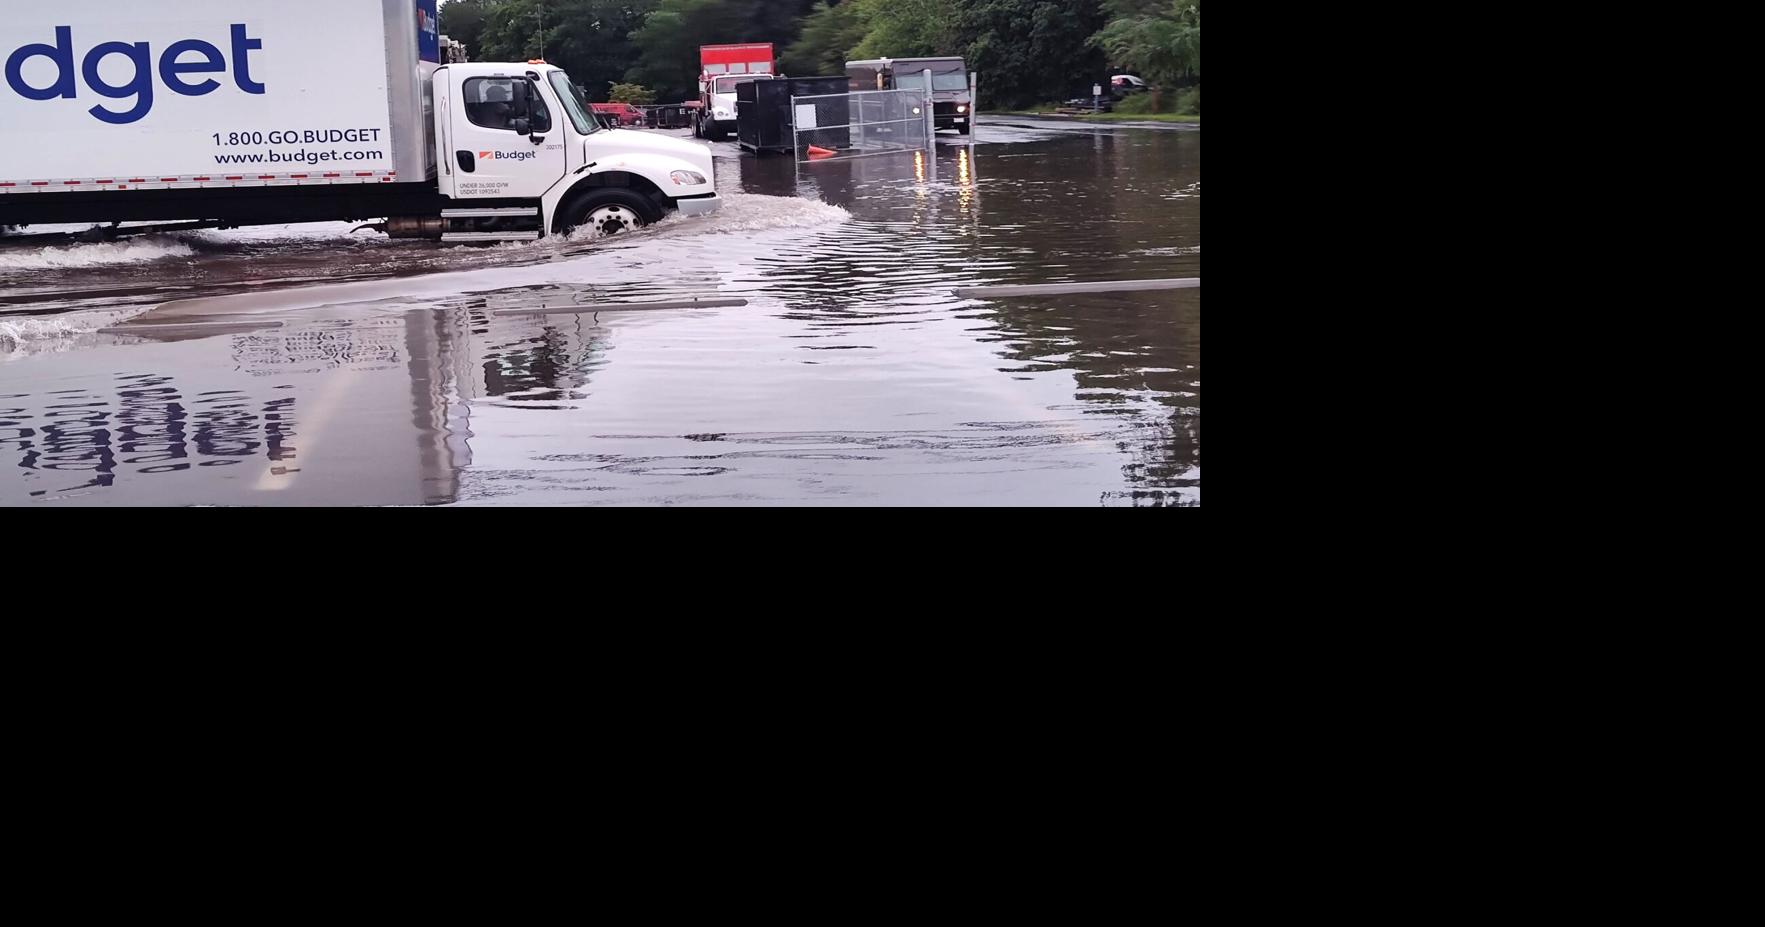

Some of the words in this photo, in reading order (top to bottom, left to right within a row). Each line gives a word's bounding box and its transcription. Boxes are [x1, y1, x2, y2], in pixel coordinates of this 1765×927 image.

[4, 23, 266, 125] dget
[212, 128, 381, 147] 1.800.GO.BUDGET
[214, 148, 383, 165] www.budget.com
[494, 150, 536, 162] Budget
